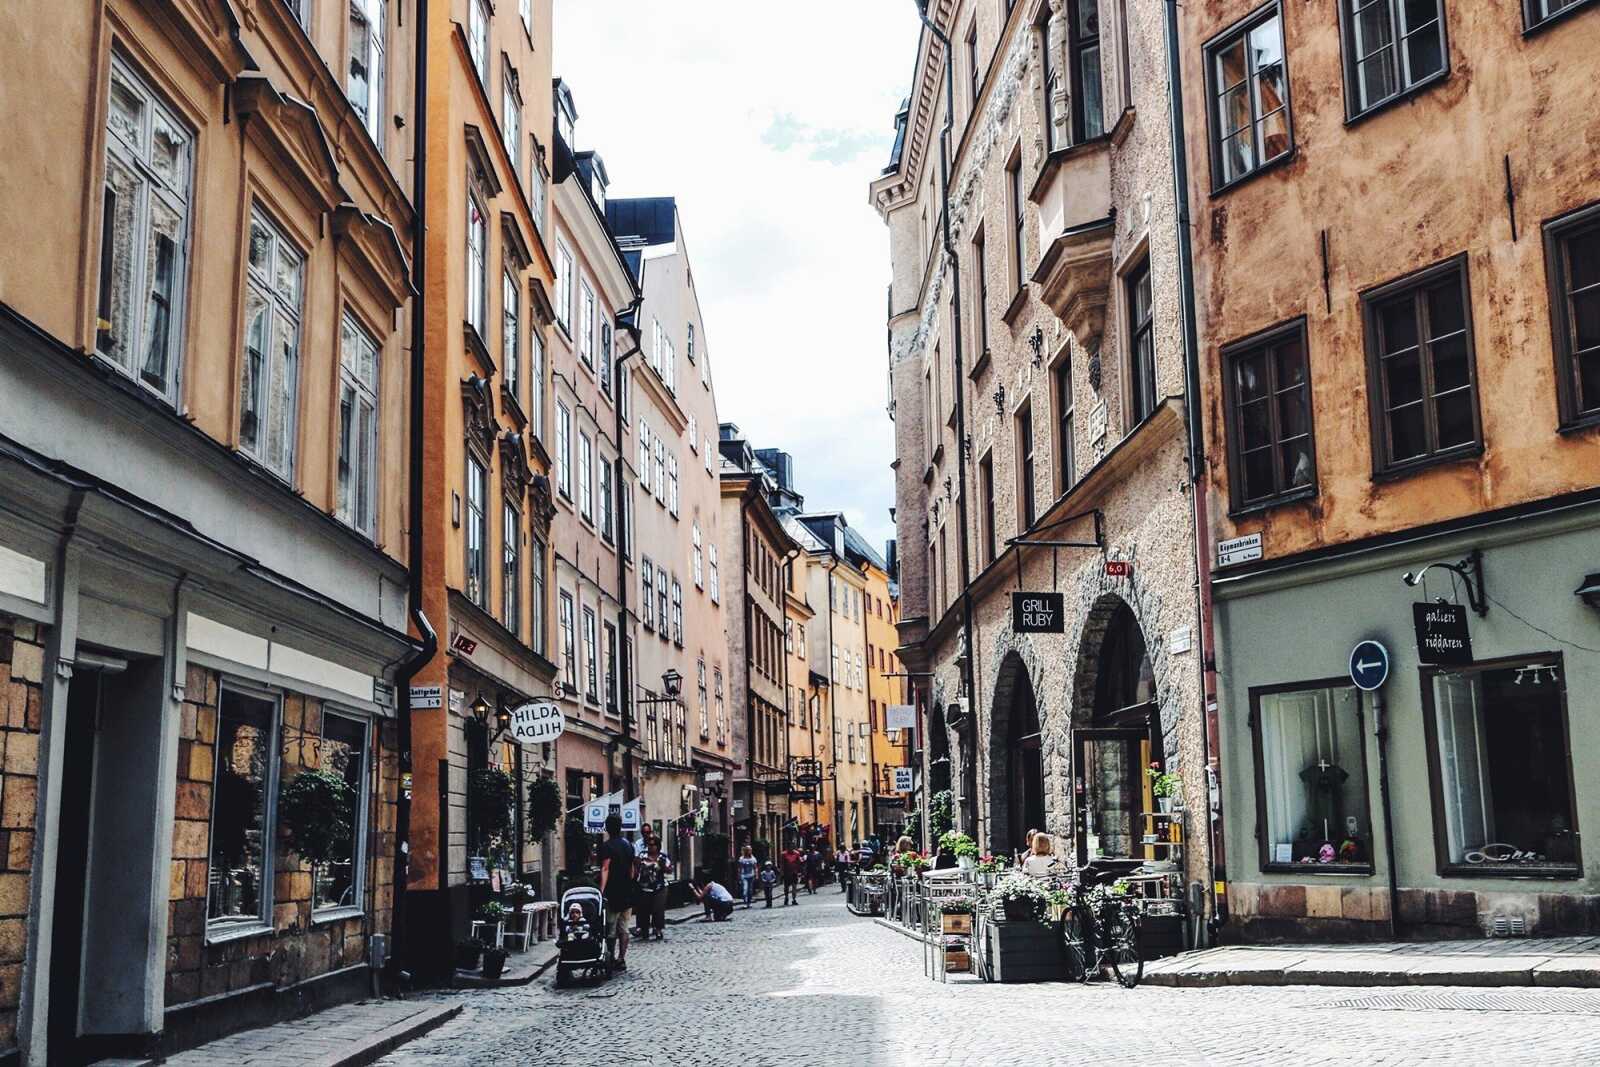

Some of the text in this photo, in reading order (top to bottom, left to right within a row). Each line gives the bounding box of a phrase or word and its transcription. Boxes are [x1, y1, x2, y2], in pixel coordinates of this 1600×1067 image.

[1022, 599, 1054, 613] GRILL
[1022, 613, 1054, 627] RUBY
[1425, 633, 1463, 653] riddaren
[514, 706, 560, 723] HILDA
